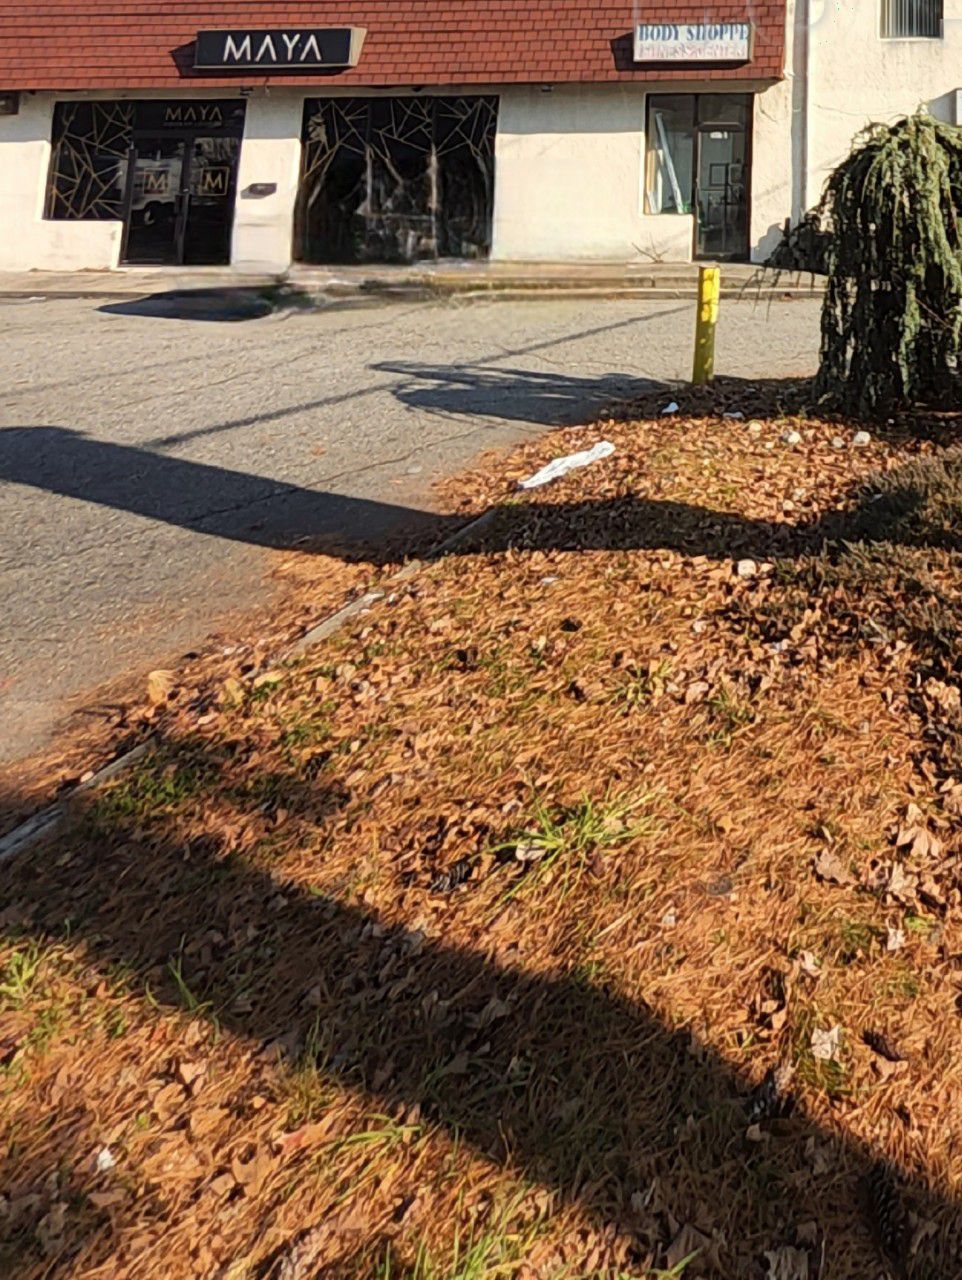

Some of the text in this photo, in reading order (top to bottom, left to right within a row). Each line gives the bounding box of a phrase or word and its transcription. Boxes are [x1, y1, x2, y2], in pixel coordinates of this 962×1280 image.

[639, 24, 679, 41] BODY
[222, 33, 322, 63] MAYA
[165, 105, 223, 121] MAYA
[148, 172, 166, 190] M
[203, 171, 223, 190] M
